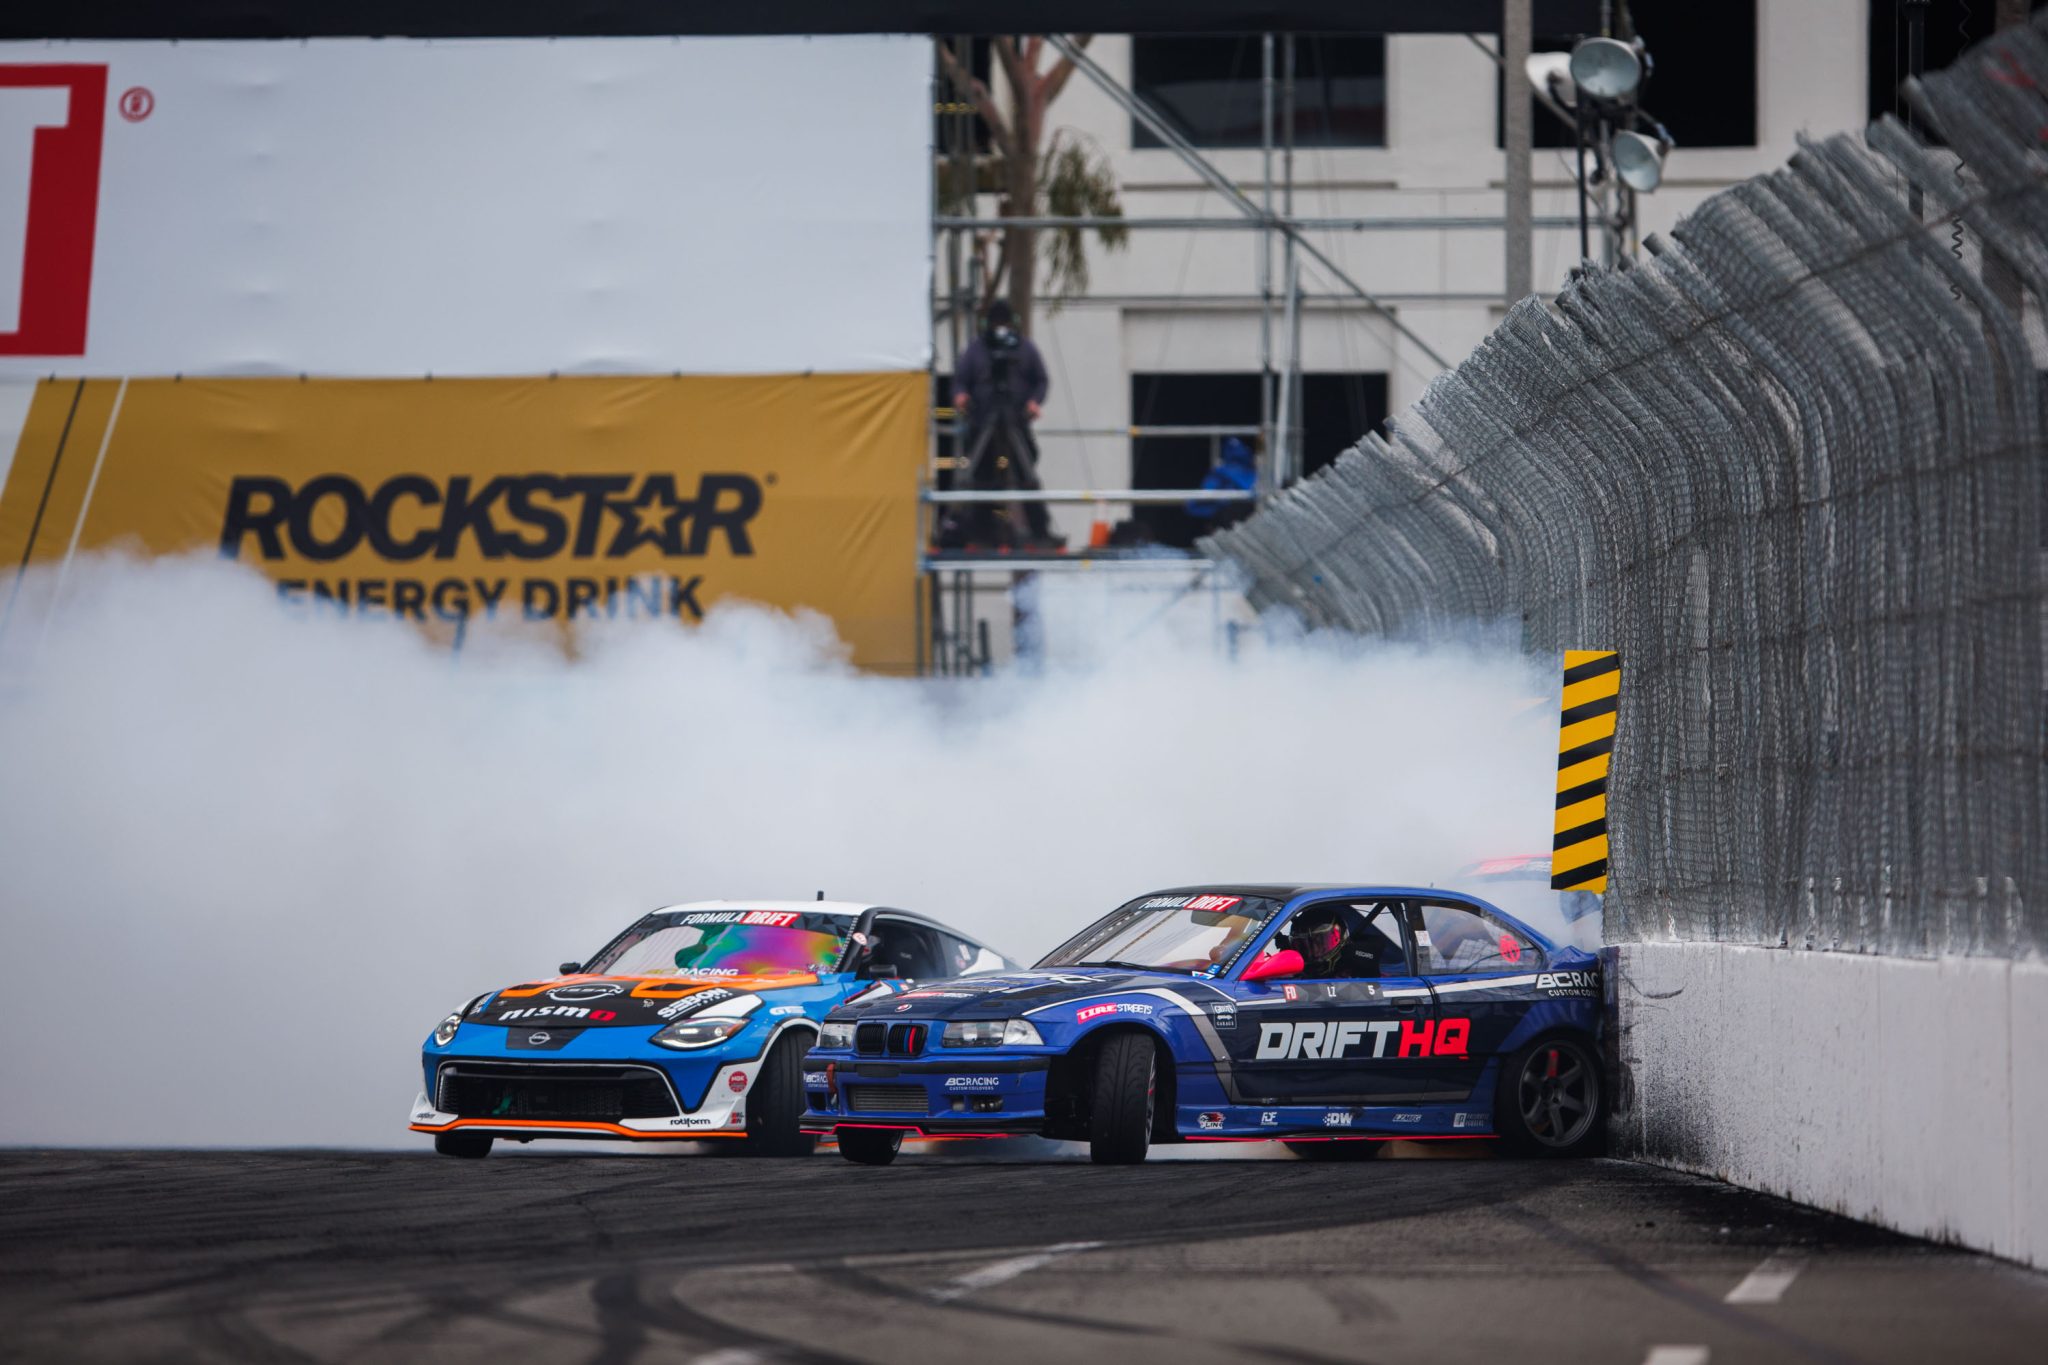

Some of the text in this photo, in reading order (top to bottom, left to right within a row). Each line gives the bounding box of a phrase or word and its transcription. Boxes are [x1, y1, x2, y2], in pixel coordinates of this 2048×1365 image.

[217, 473, 763, 561] ROCKSTAR
[522, 574, 707, 623] DRINK
[1186, 895, 1240, 911] DRIFT
[680, 911, 798, 926] FORMULA DRIFT
[1284, 985, 1297, 1000] FD
[1367, 984, 1376, 996] 5
[1548, 989, 1581, 997] CUSTOM
[670, 1117, 711, 1127] rotiform
